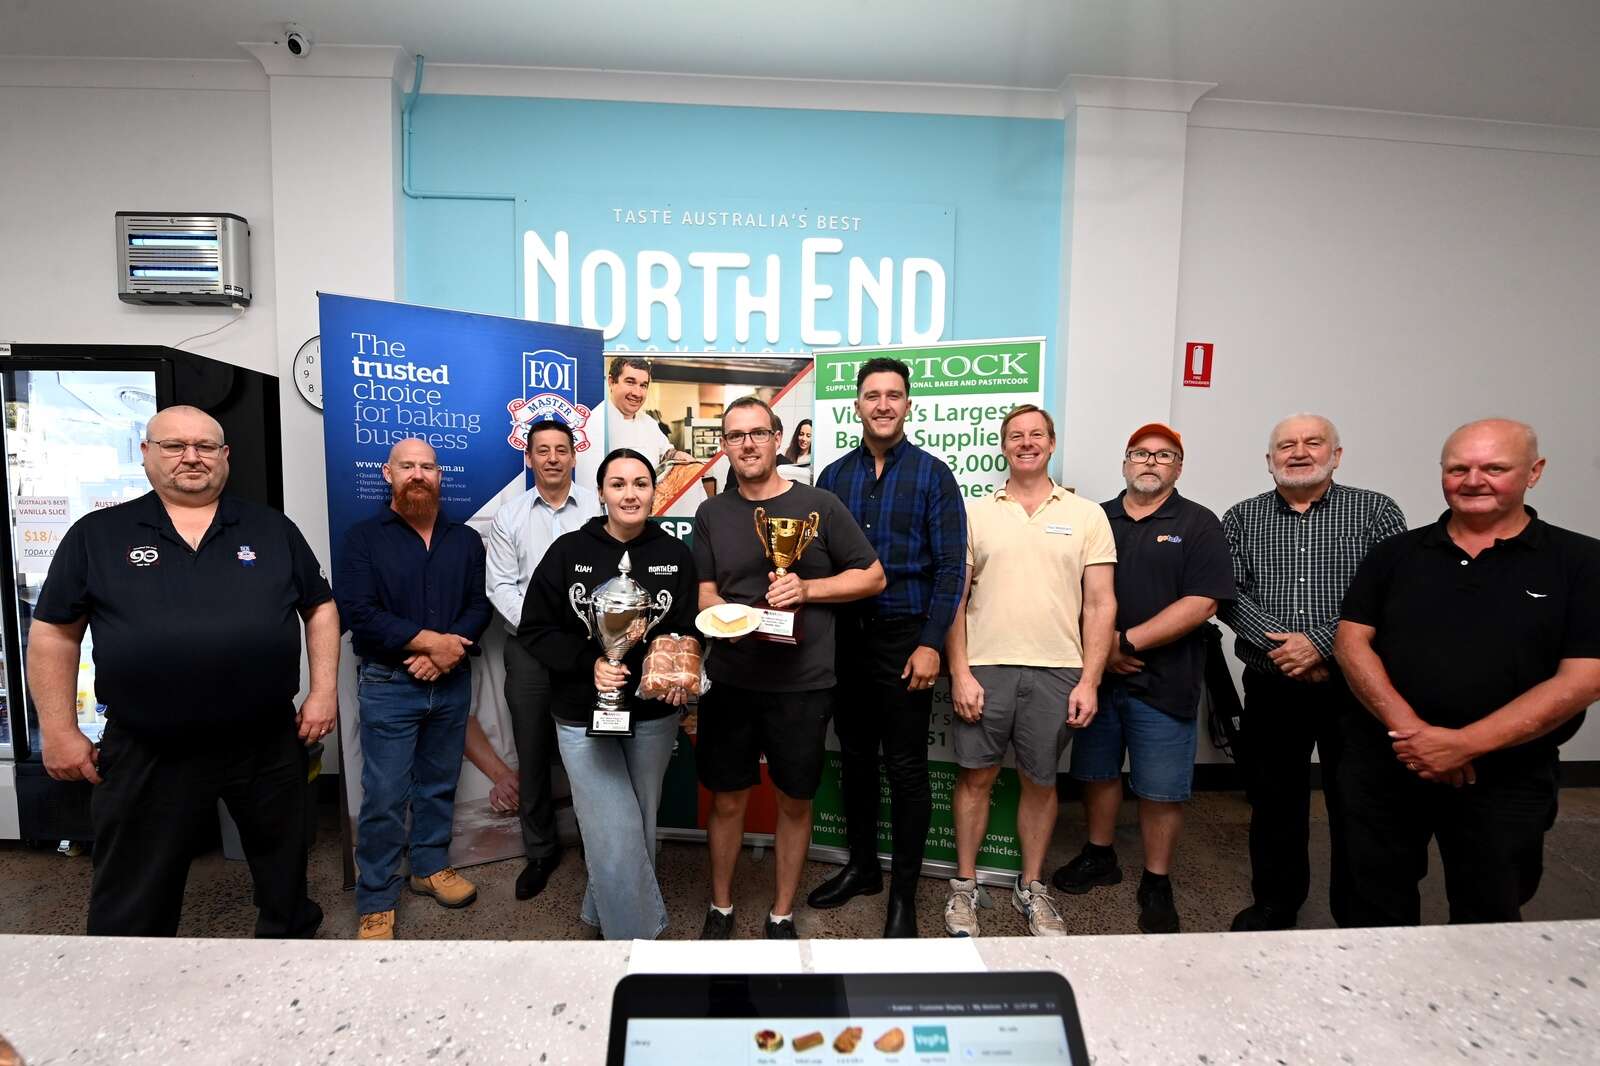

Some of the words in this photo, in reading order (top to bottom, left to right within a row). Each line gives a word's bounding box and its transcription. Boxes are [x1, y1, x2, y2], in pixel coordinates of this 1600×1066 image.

[613, 208, 672, 224] TASTE
[681, 211, 808, 229] AUSTRALIA'S
[816, 215, 863, 231] BEST
[352, 332, 406, 358] The
[306, 355, 314, 364] 10
[352, 356, 450, 385] trusted
[827, 353, 1028, 382] TSTOCK
[303, 369, 310, 379] 9
[528, 360, 572, 391] EOI
[308, 384, 315, 393] 8
[353, 379, 441, 406] choice
[825, 384, 858, 392] SUPPLYIN
[354, 401, 391, 423] for
[396, 404, 481, 434] baking
[527, 397, 572, 417] MASTER
[934, 402, 1017, 426] Larges
[354, 423, 469, 450] business
[914, 427, 999, 452] Supplie
[24, 549, 48, 557] TODAY
[130, 549, 159, 563] 90
[813, 824, 836, 834] most
[986, 833, 1015, 843] cover
